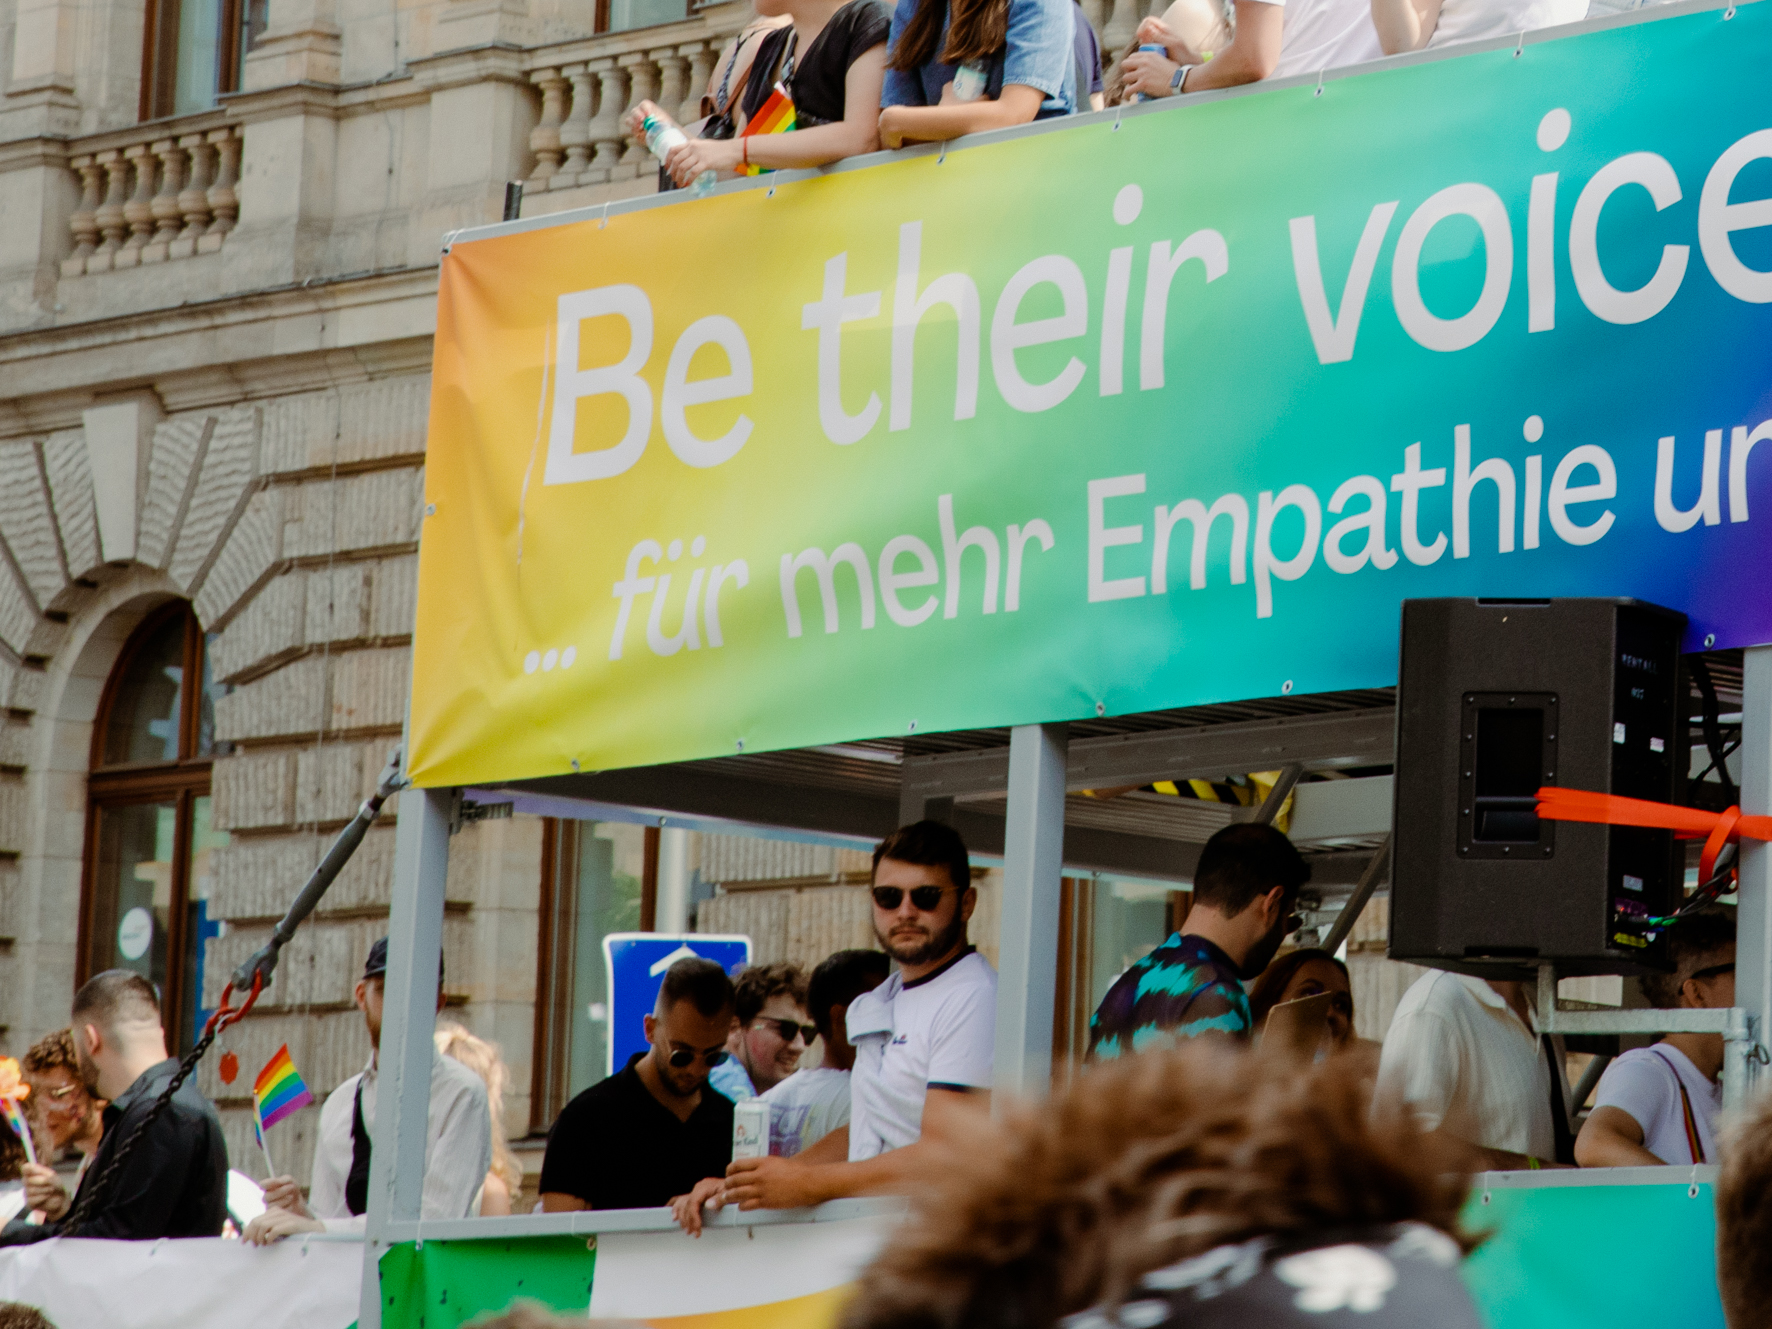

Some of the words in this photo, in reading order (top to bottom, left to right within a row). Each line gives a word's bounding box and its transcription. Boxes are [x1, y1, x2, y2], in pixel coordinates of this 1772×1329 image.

[543, 283, 754, 486] Be
[801, 184, 1229, 446] their
[608, 536, 749, 661] für
[781, 495, 1054, 636] mehr
[1085, 414, 1615, 619] Empathie
